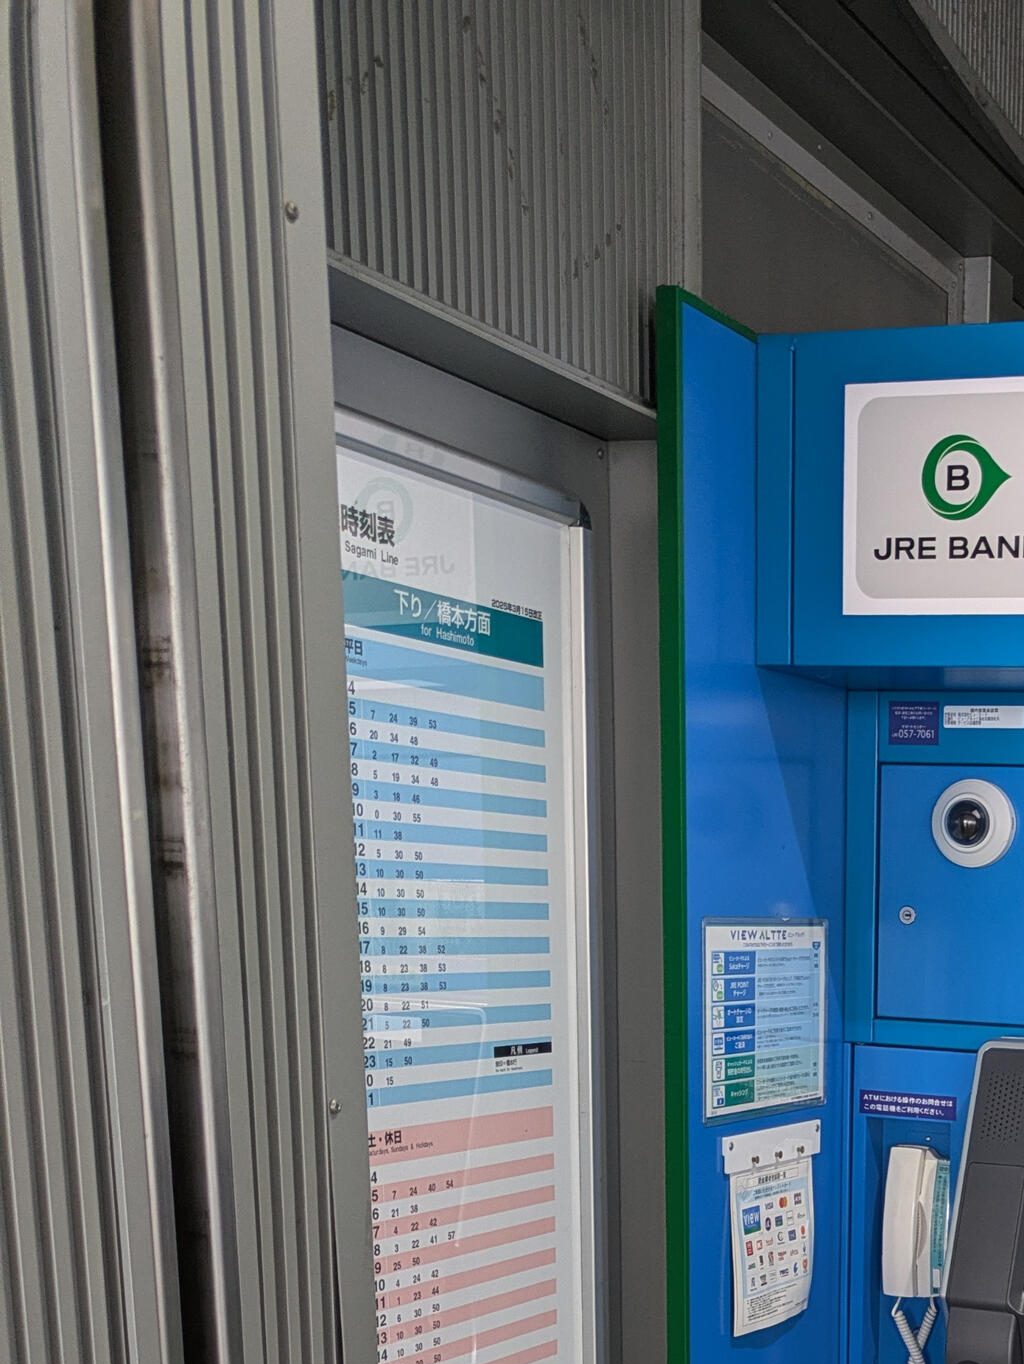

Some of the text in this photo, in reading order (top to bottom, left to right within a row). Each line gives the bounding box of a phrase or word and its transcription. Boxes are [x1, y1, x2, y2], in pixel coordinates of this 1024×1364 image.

[340, 503, 396, 547] 時刻表
[345, 540, 399, 566] Sagami Line
[874, 537, 938, 561] JRE
[344, 638, 363, 656] 平日
[421, 625, 475, 648] for Hashimoto
[349, 701, 437, 729] 5 7 24 39 53
[350, 722, 418, 746] 6 20 34 48
[350, 742, 438, 768] 7 2 17 32 49
[730, 930, 757, 941] VIEW
[759, 929, 788, 940] ALTTE
[368, 1131, 402, 1149] 土・休日
[371, 1180, 454, 1202] 5 7 24 40 54
[374, 1231, 455, 1256] 8 3 22 41 57
